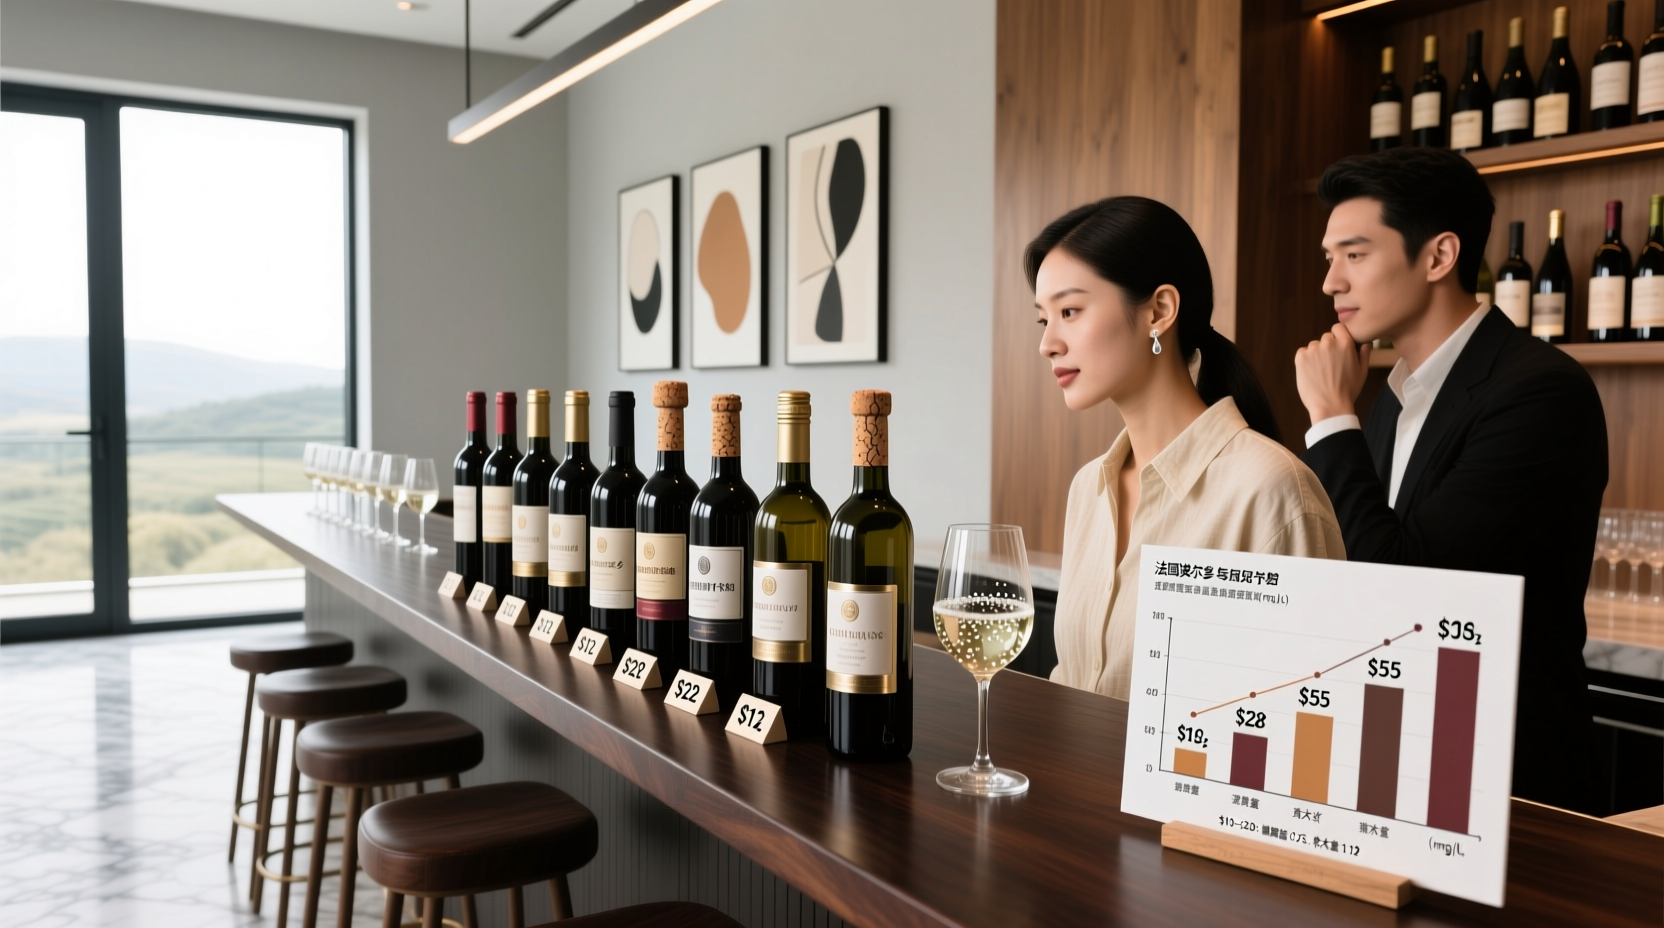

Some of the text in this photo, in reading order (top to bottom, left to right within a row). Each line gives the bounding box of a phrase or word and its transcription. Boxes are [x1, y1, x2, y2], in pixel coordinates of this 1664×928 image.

[577, 635, 596, 655] $12
[1368, 657, 1402, 679] $55
[674, 679, 700, 703] $22
[1298, 687, 1332, 709] $55
[737, 704, 765, 732] $12
[1236, 707, 1267, 729] $28
